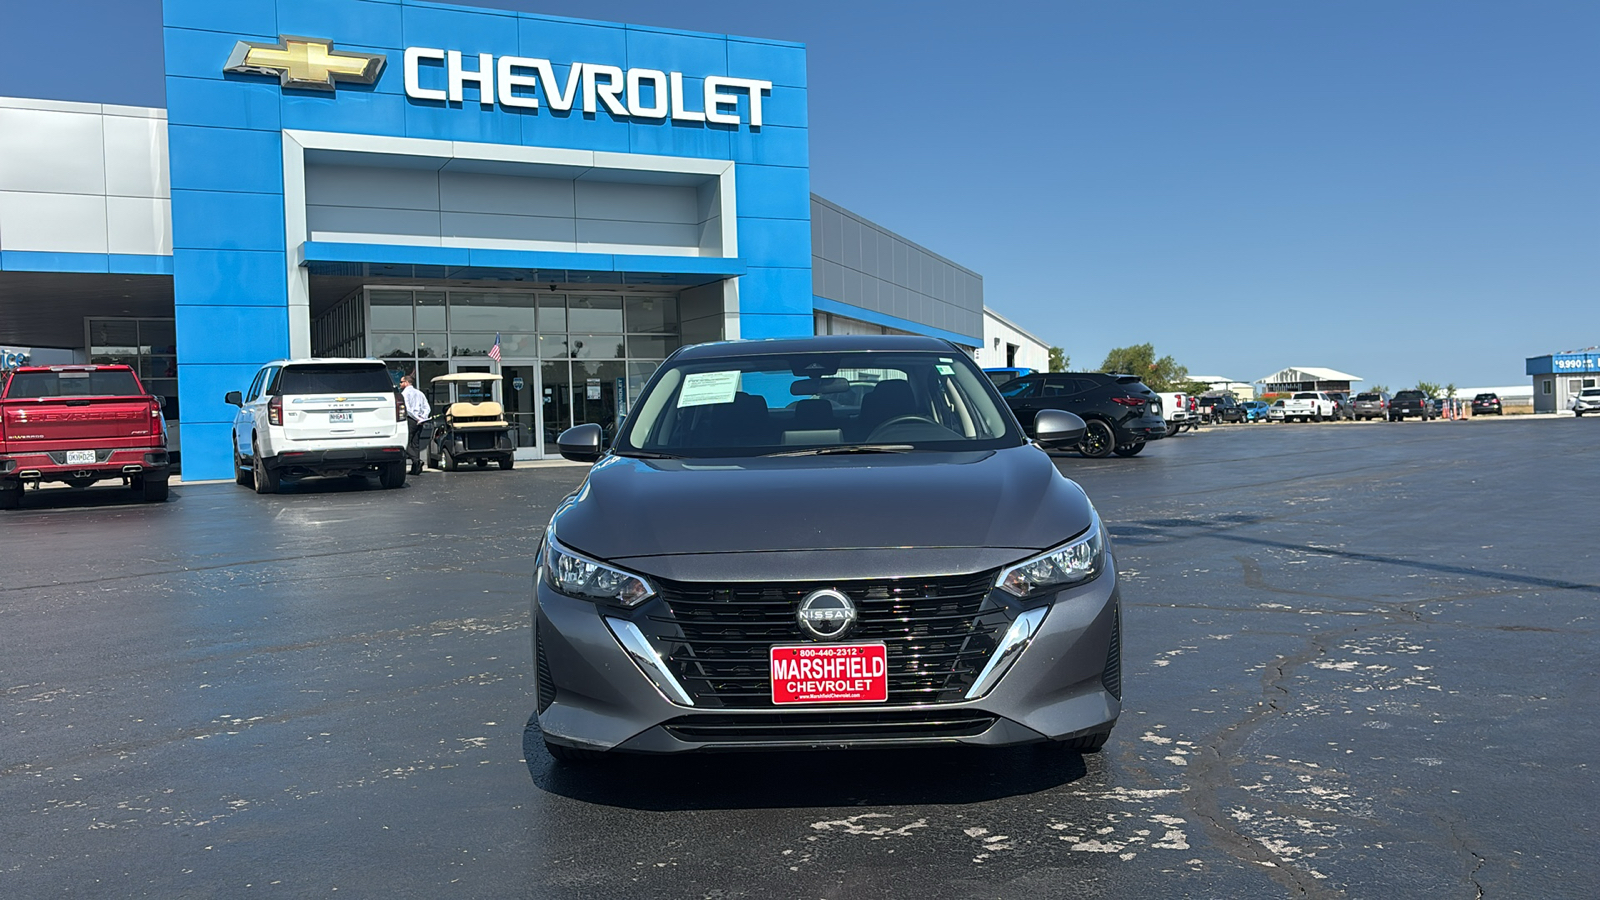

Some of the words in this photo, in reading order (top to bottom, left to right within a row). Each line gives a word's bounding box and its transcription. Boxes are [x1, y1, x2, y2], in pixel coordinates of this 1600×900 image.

[404, 46, 772, 127] CHEVROLET
[800, 609, 854, 619] NISSAN
[800, 648, 857, 657] 800-440-2312
[773, 656, 884, 680] MARSHFIELD
[786, 679, 872, 693] CHEVROLET
